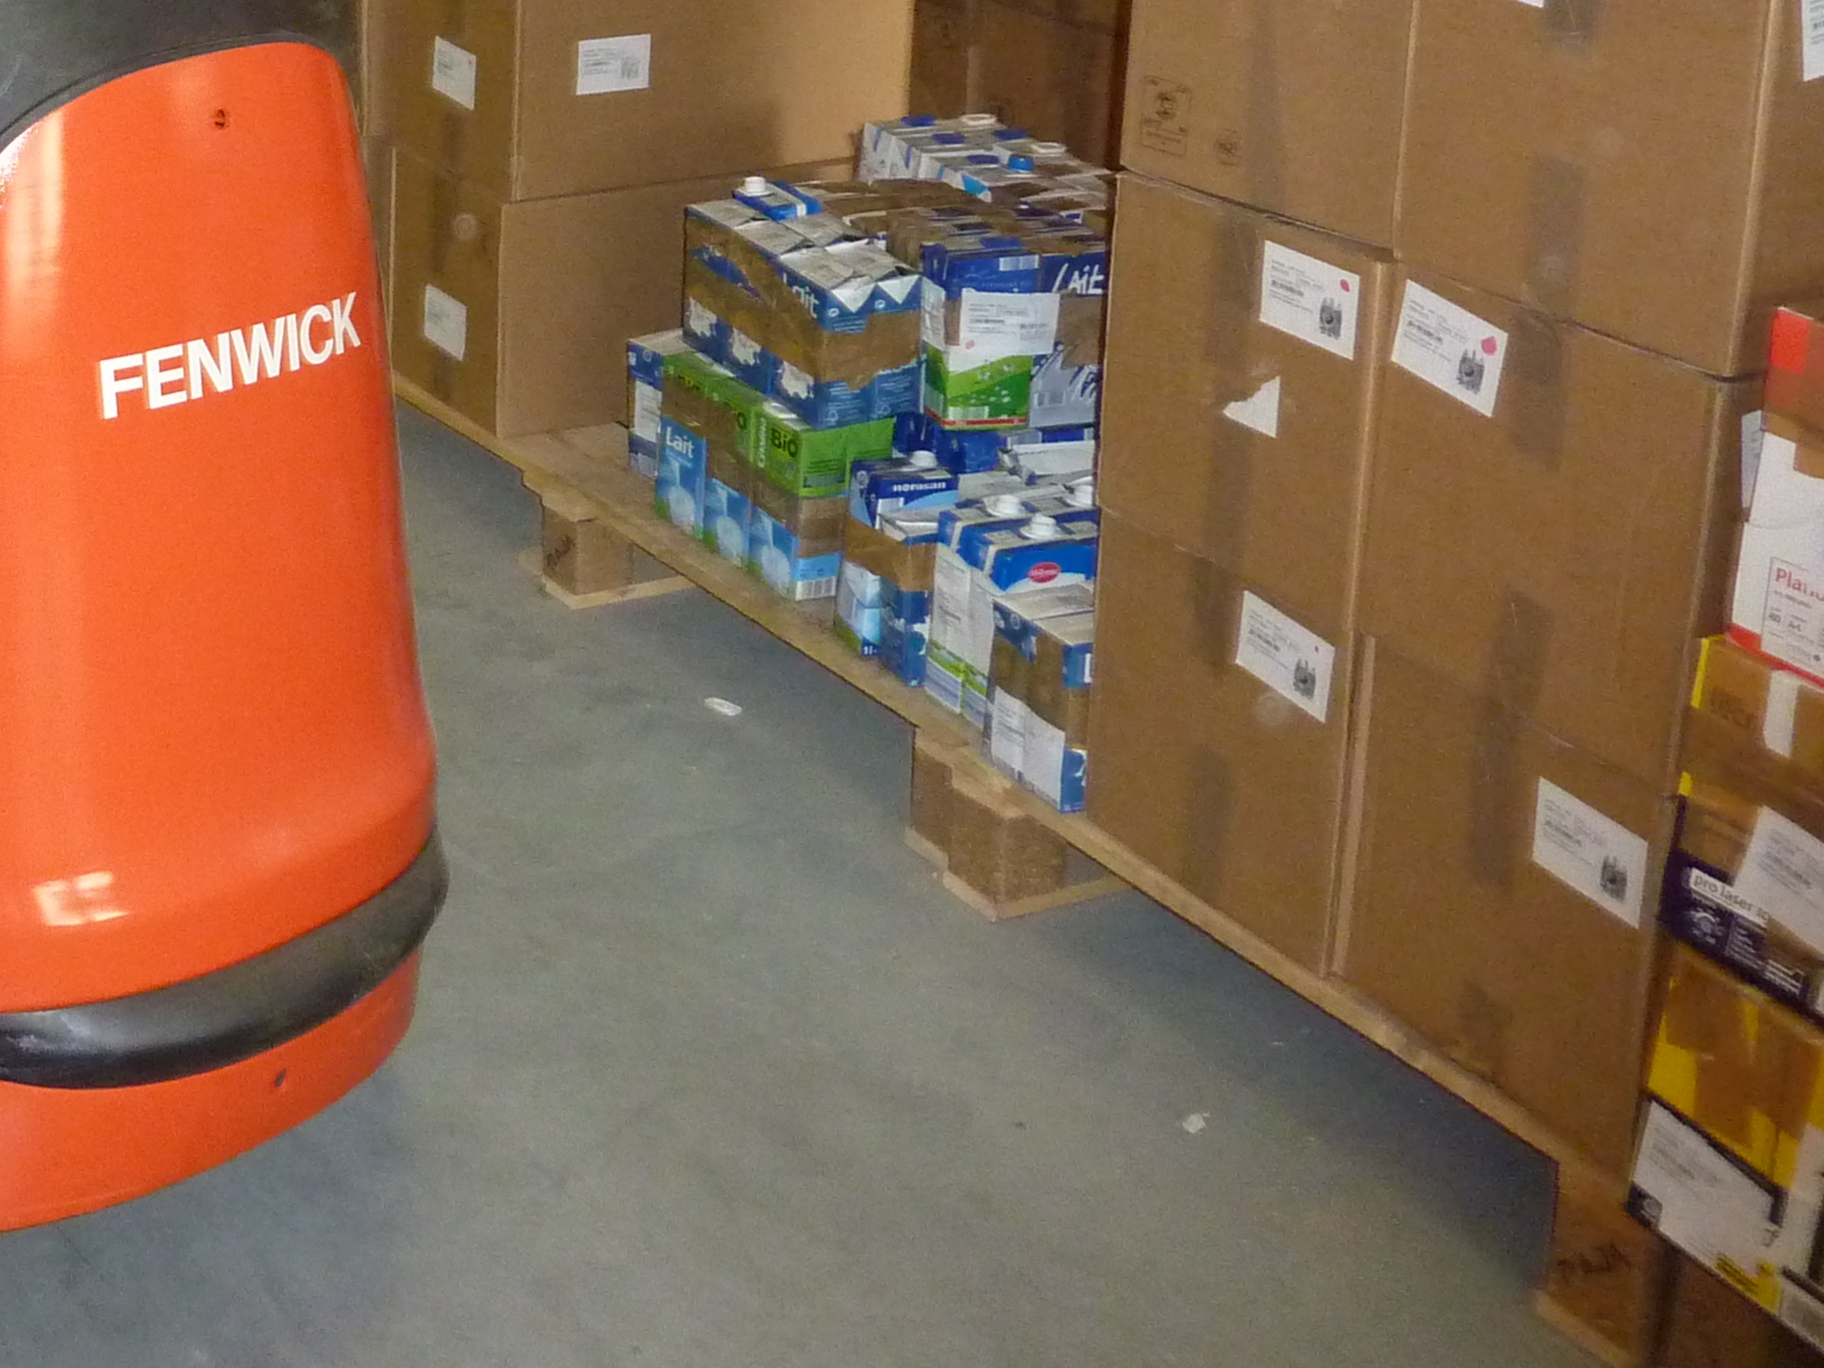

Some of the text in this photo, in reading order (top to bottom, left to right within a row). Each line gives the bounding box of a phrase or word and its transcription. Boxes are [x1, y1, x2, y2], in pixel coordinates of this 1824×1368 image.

[99, 291, 361, 420] FENWICK
[666, 427, 695, 459] Lait
[1694, 874, 1717, 893] pro
